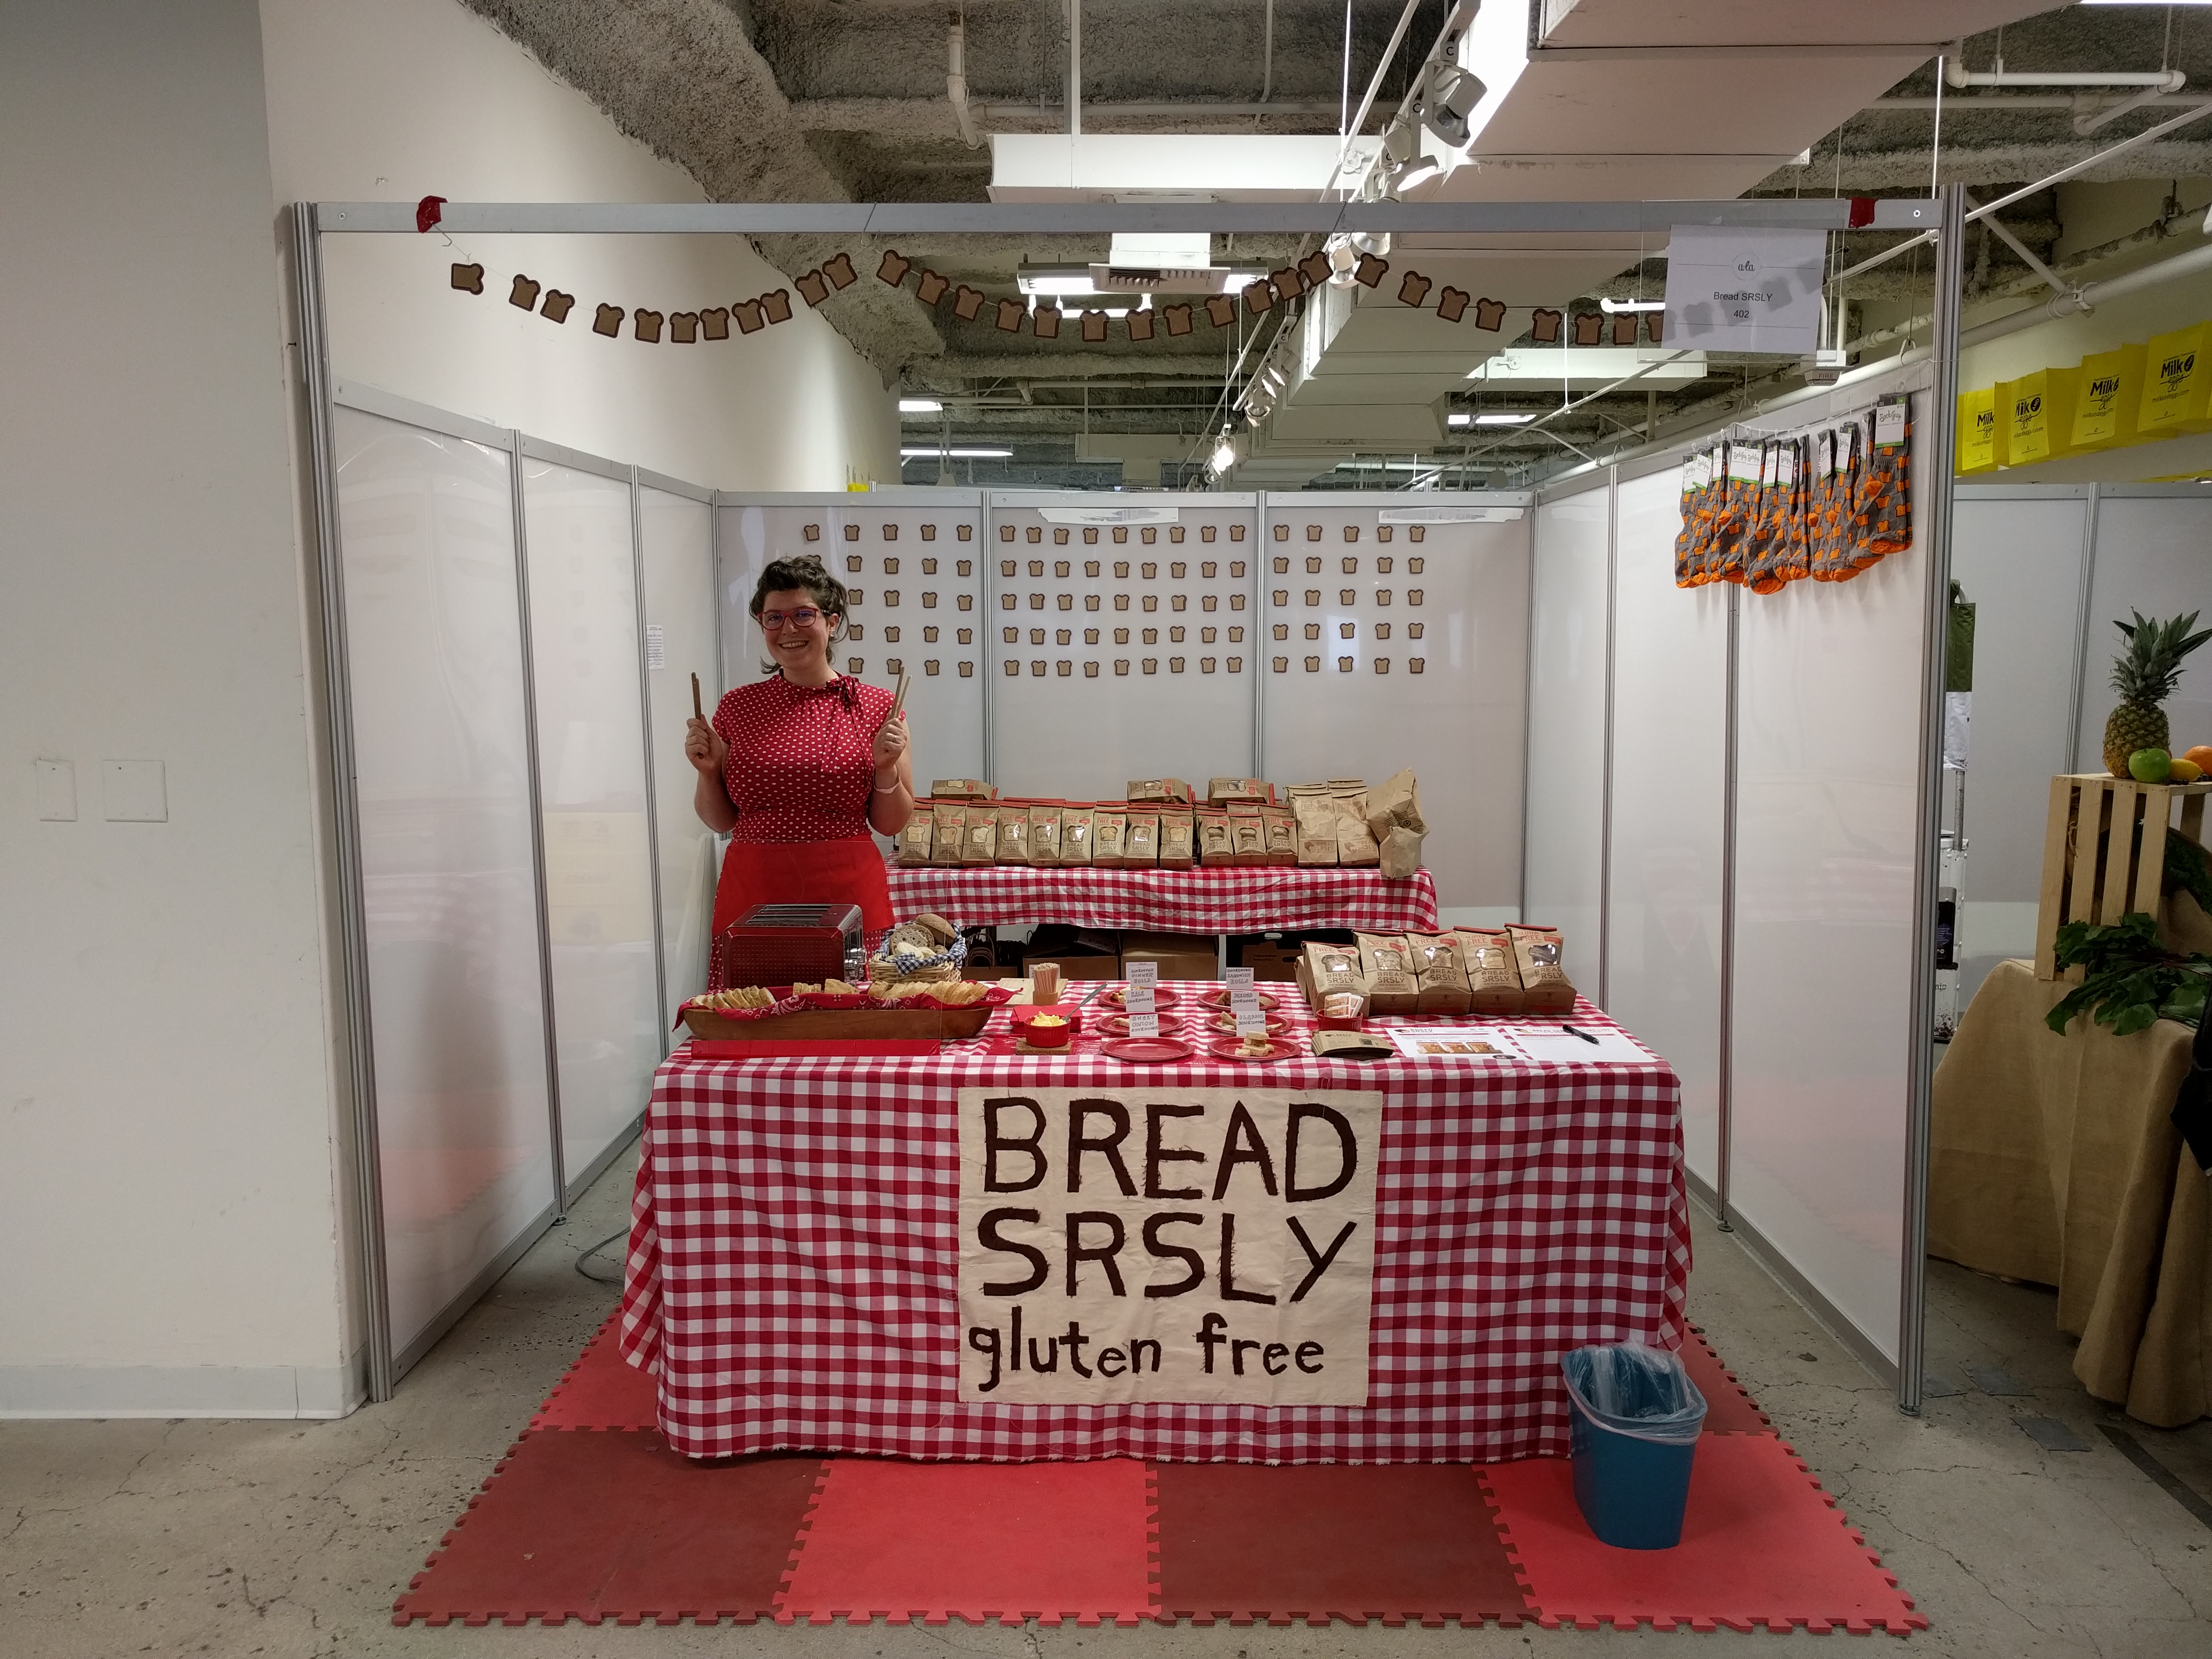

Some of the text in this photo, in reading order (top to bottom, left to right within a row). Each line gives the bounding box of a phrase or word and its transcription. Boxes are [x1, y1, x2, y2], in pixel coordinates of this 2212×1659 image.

[1446, 47, 1454, 56] C
[1413, 103, 1421, 113] C
[1713, 292, 1773, 302] Bread SRSLY
[1733, 310, 1750, 318] 402
[2160, 359, 2183, 379] Milk
[2090, 379, 2113, 396] Milk
[983, 1097, 1359, 1203] BREAD
[978, 1207, 1357, 1305] SRSLY
[968, 1306, 1324, 1392] gluten free
